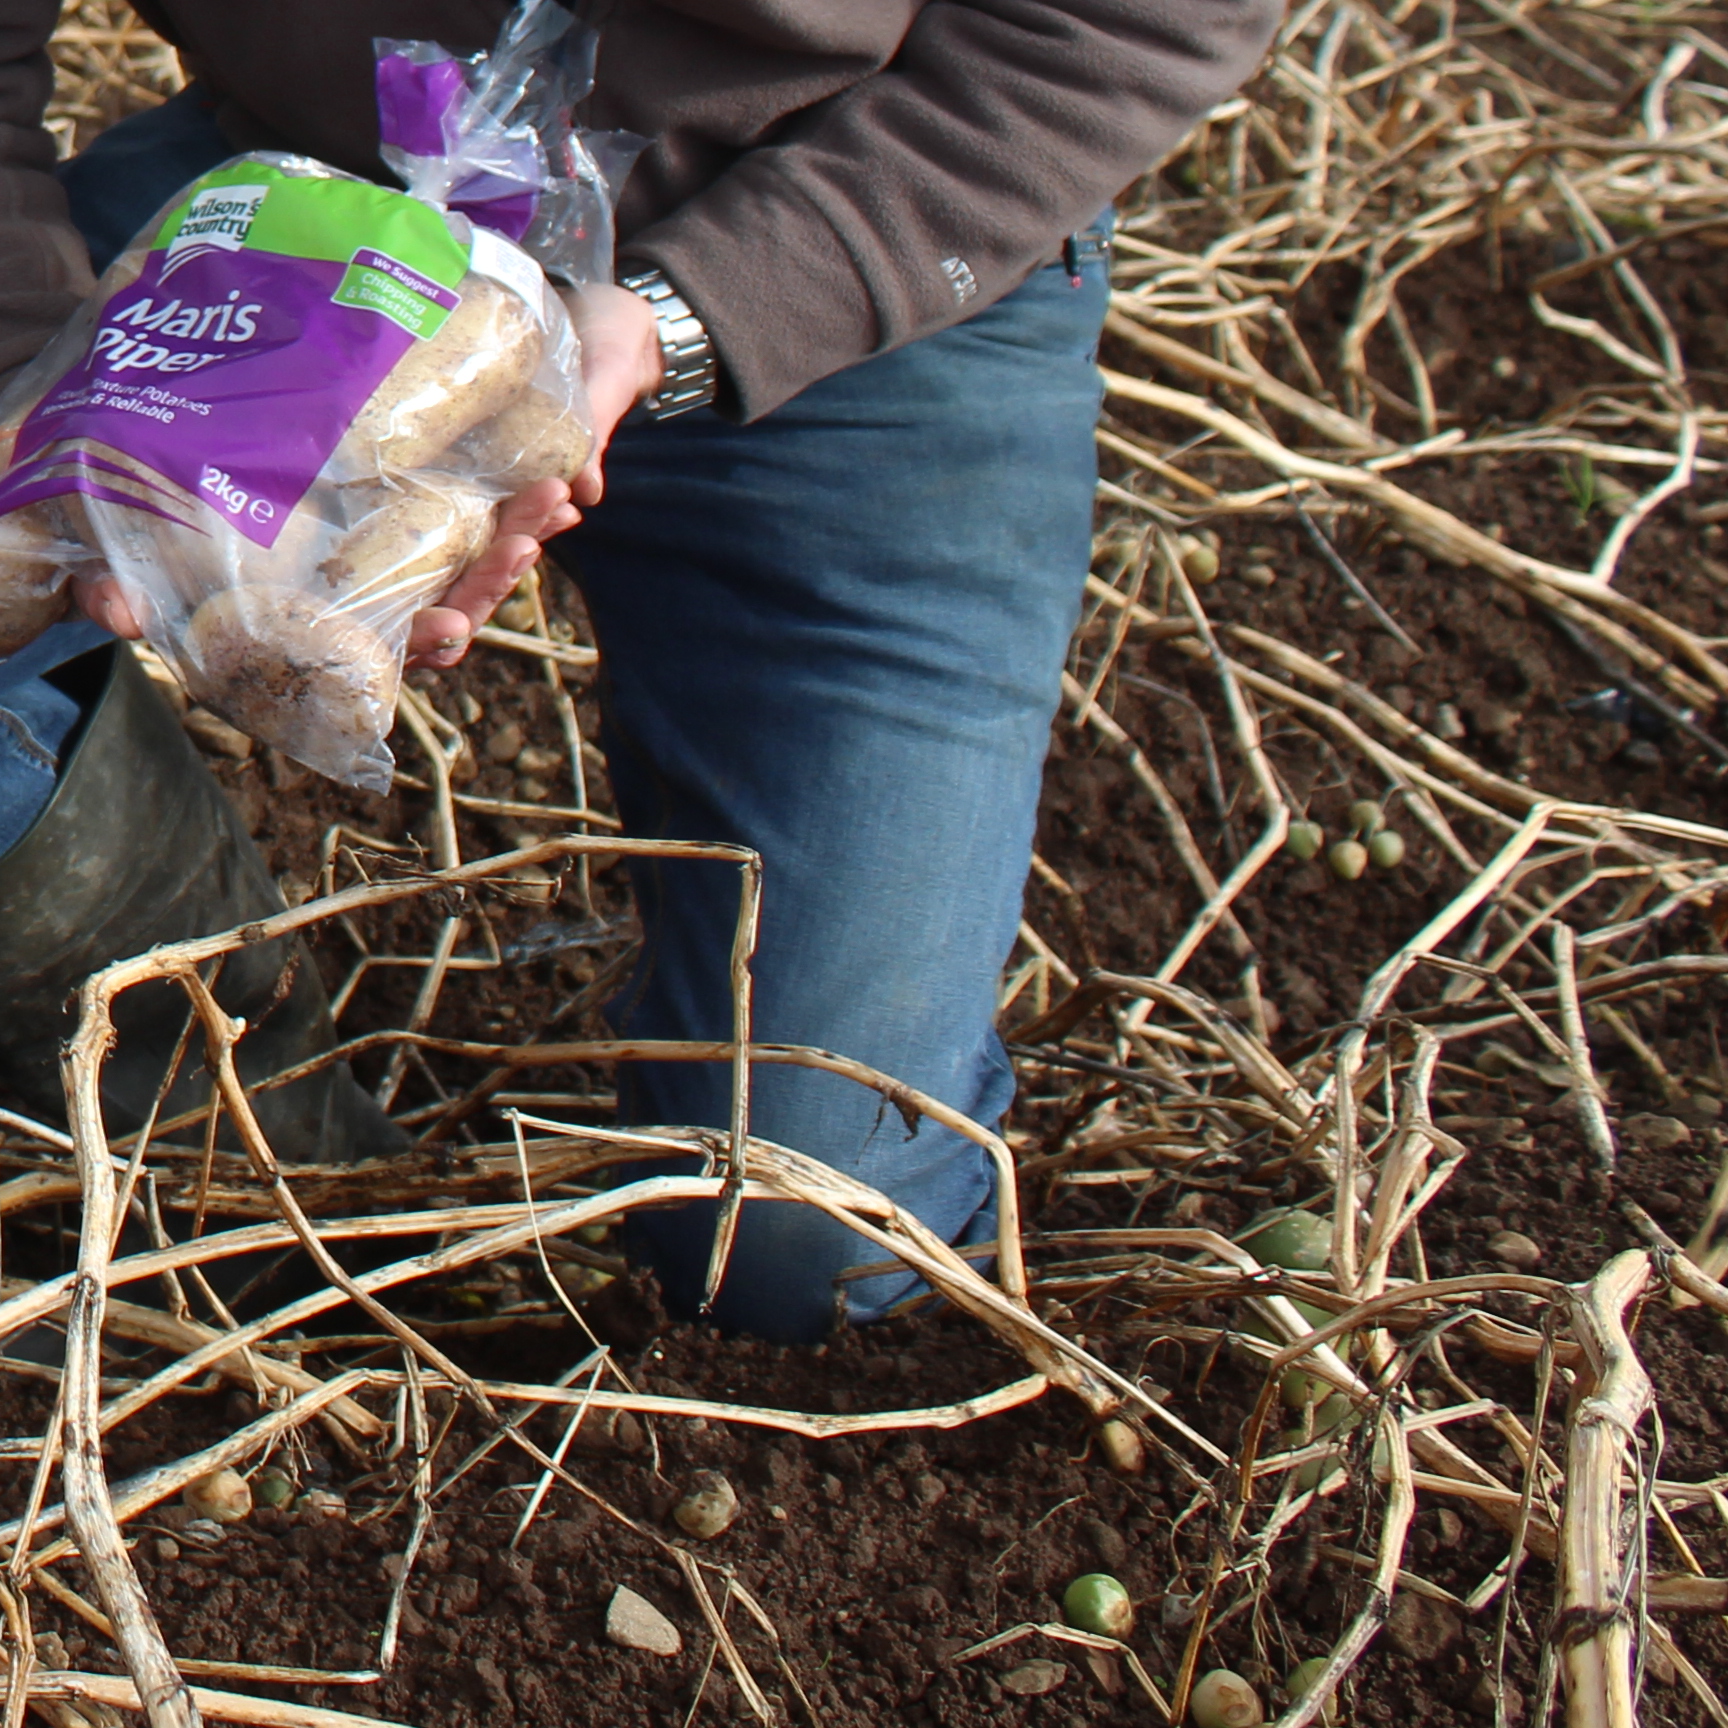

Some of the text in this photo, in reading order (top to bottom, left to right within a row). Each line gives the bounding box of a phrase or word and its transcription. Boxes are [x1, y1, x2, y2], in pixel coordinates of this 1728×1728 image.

[361, 272, 428, 316] Chipping
[372, 256, 439, 301] We Suggest
[112, 290, 263, 342] Maris
[359, 286, 424, 331] Roasting
[85, 328, 226, 373] Piper
[105, 395, 176, 423] Reliable
[139, 385, 213, 416] Potatoes
[200, 467, 249, 514] 2kg
